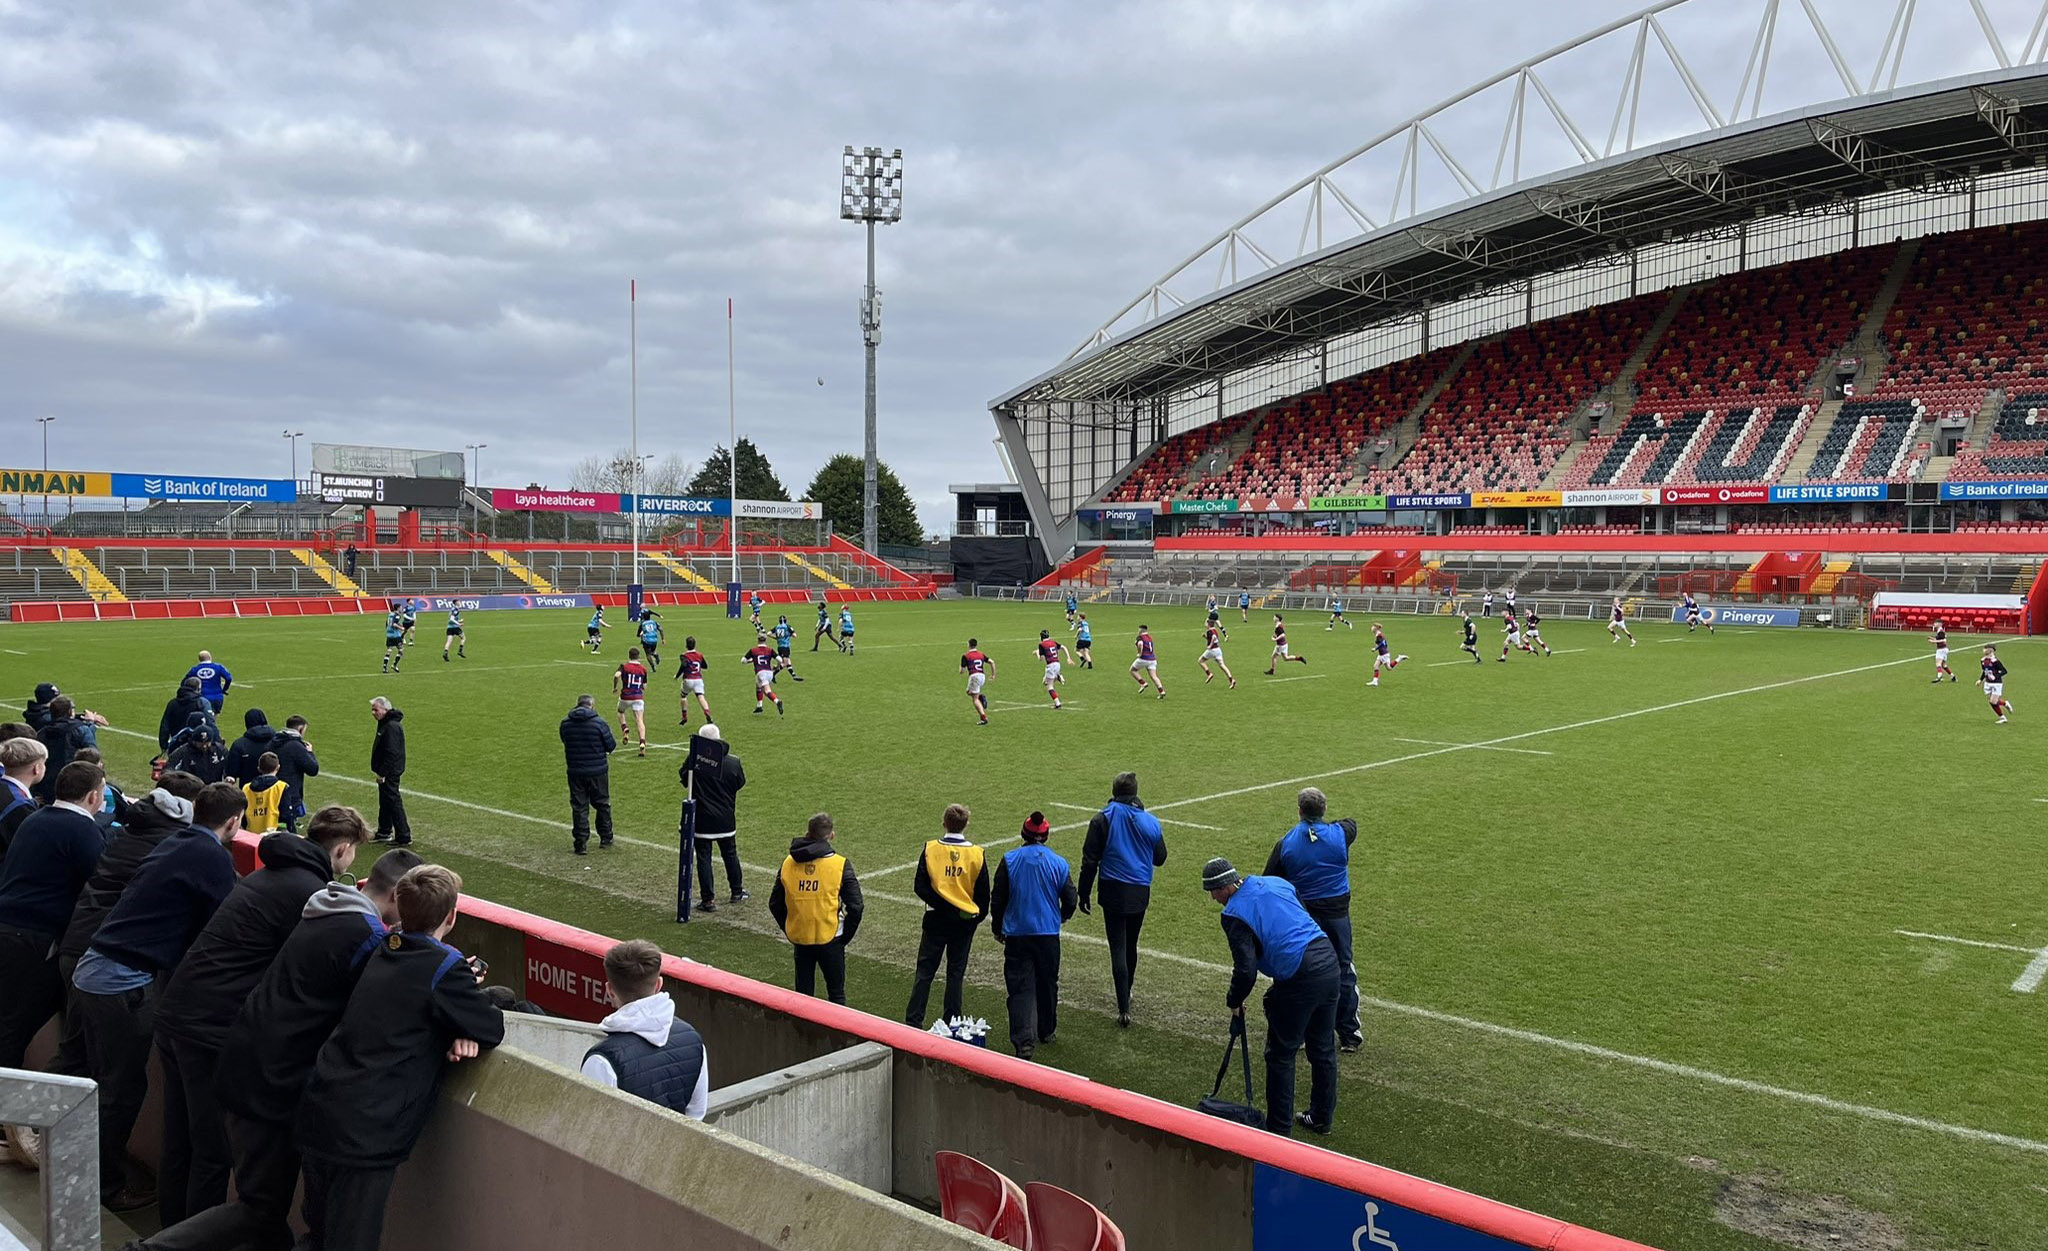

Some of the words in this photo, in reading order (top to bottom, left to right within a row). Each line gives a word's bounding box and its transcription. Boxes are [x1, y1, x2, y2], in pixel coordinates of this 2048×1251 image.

[1, 472, 86, 494] NMAN
[165, 480, 200, 495] Bank
[202, 482, 217, 496] of
[220, 483, 267, 497] Ireland
[322, 488, 374, 499] CASTLETROY
[1678, 491, 1710, 499] vodafone
[1731, 490, 1764, 498] vodafone
[1776, 487, 1798, 499] LIFE
[1801, 487, 1834, 498] STYLE
[1836, 485, 1879, 497] SPORTS
[1967, 485, 1998, 495] Bank
[1999, 484, 2014, 495] of
[515, 493, 538, 506] laya
[540, 494, 596, 507] healthcare
[1324, 498, 1368, 507] GILBERT
[1396, 498, 1411, 506] LIFE
[1412, 497, 1433, 506] STYLE
[1434, 496, 1462, 505] SPORTS
[1525, 495, 1552, 503] DHL
[1567, 493, 1607, 503] shannon
[1608, 493, 1638, 502] AIRPORT
[642, 498, 713, 512] RIVERROCK
[742, 504, 776, 515] shannon
[777, 507, 802, 515] AIRPORT
[1180, 503, 1204, 511] Master
[1205, 501, 1228, 511] Chefs
[1106, 510, 1136, 520] Pinergy
[436, 598, 480, 609] Pinrgy
[536, 596, 576, 608] Pinergy
[1722, 611, 1775, 624] Pinergy
[1049, 646, 1058, 658] 5
[691, 661, 700, 674] 3
[973, 659, 983, 671] 2
[627, 673, 642, 689] 14
[528, 957, 577, 995] HOME
[581, 975, 616, 1007] TEA
